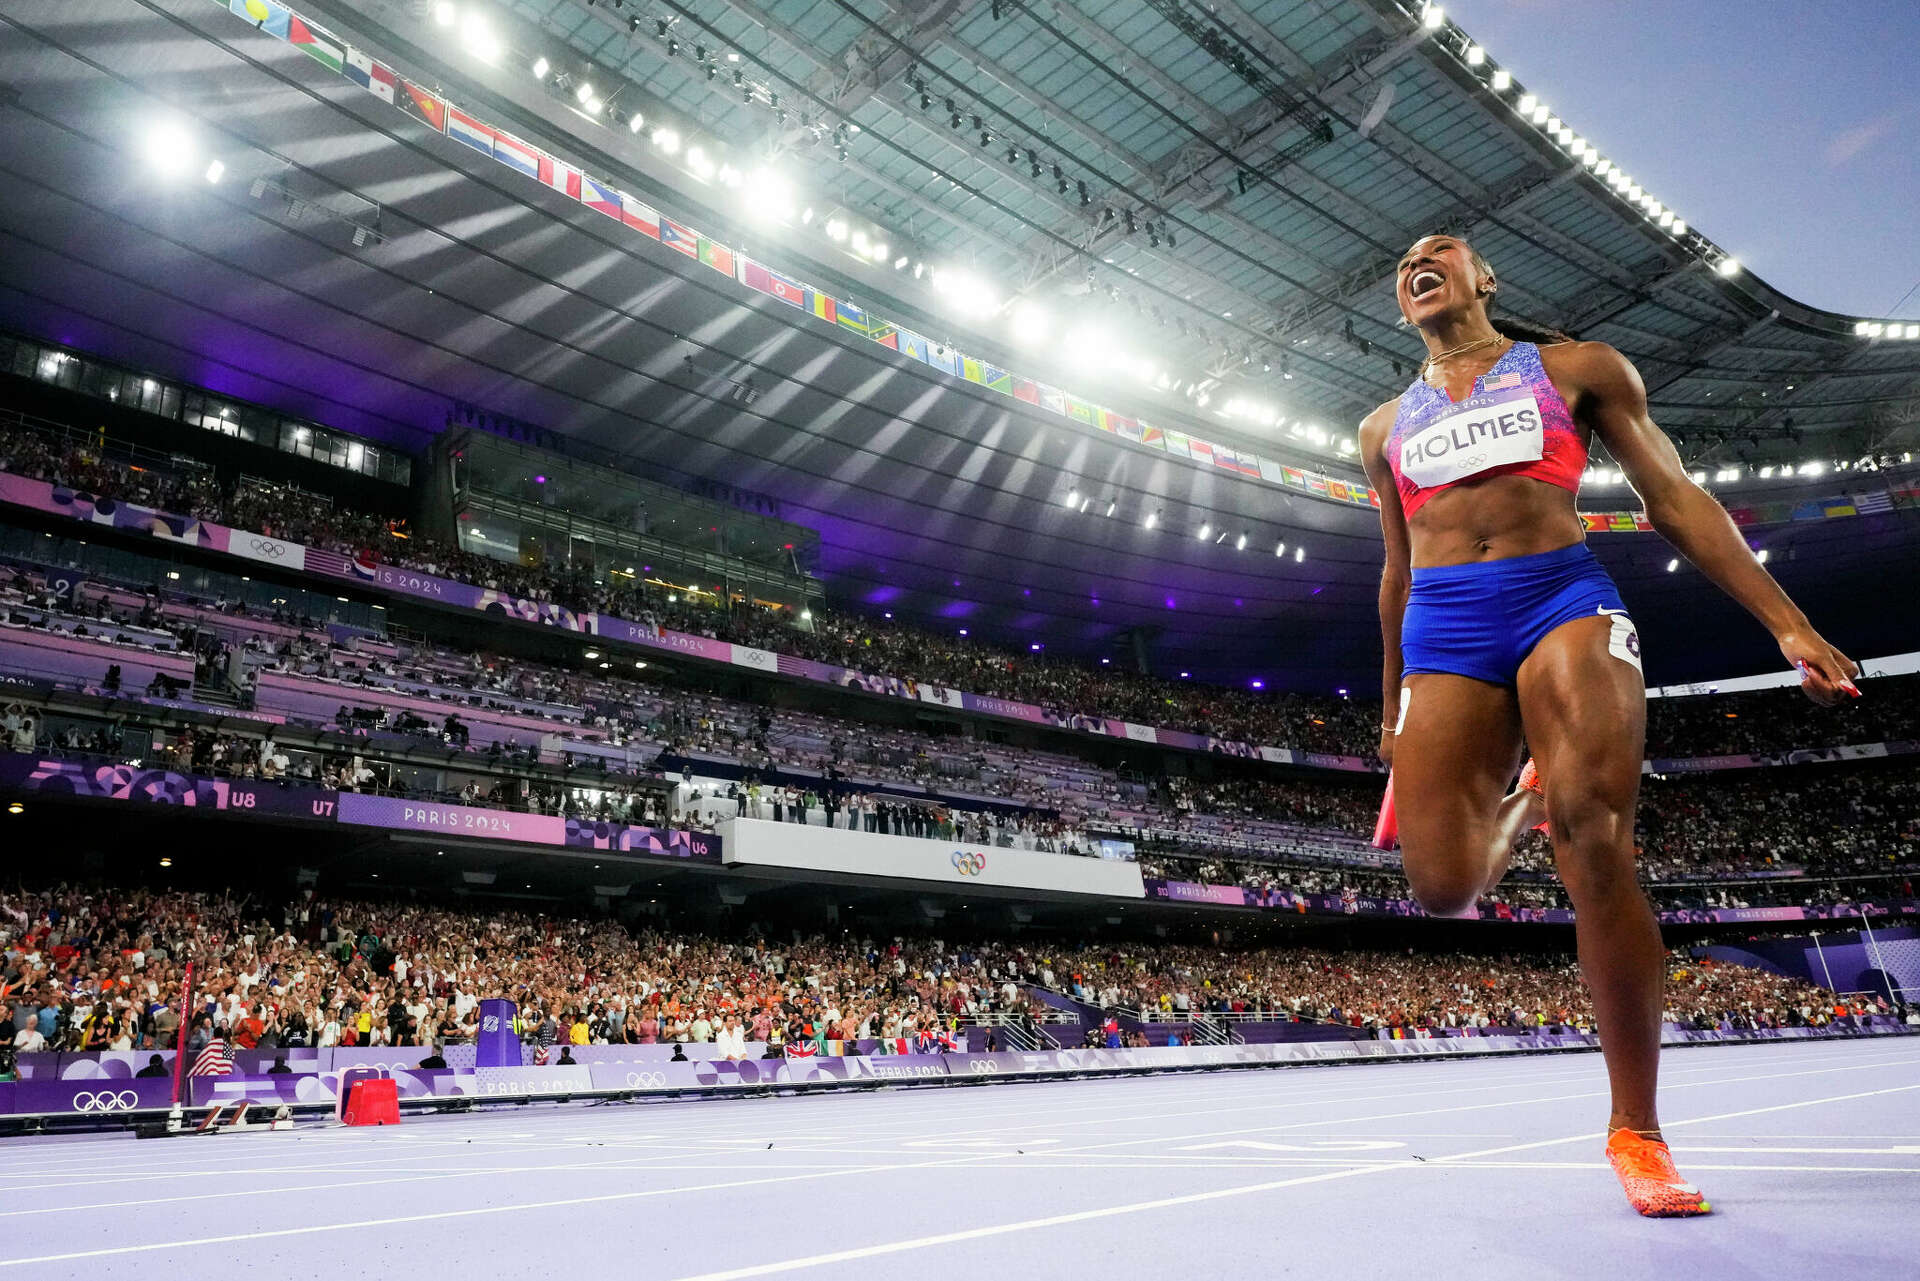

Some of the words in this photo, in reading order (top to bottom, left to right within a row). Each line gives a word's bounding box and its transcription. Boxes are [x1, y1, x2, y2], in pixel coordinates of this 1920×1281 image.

[1430, 403, 1460, 425] PARIS
[1463, 398, 1496, 410] 2024
[1405, 409, 1538, 467] HOLMES
[343, 562, 392, 584] PIS
[400, 575, 441, 595] 2024
[671, 635, 704, 652] 2024
[231, 791, 256, 808] U8
[312, 799, 335, 817] U7
[404, 807, 458, 827] PARIS
[465, 814, 510, 832] 2024
[692, 841, 708, 855] U6
[487, 1081, 536, 1095] PARIS
